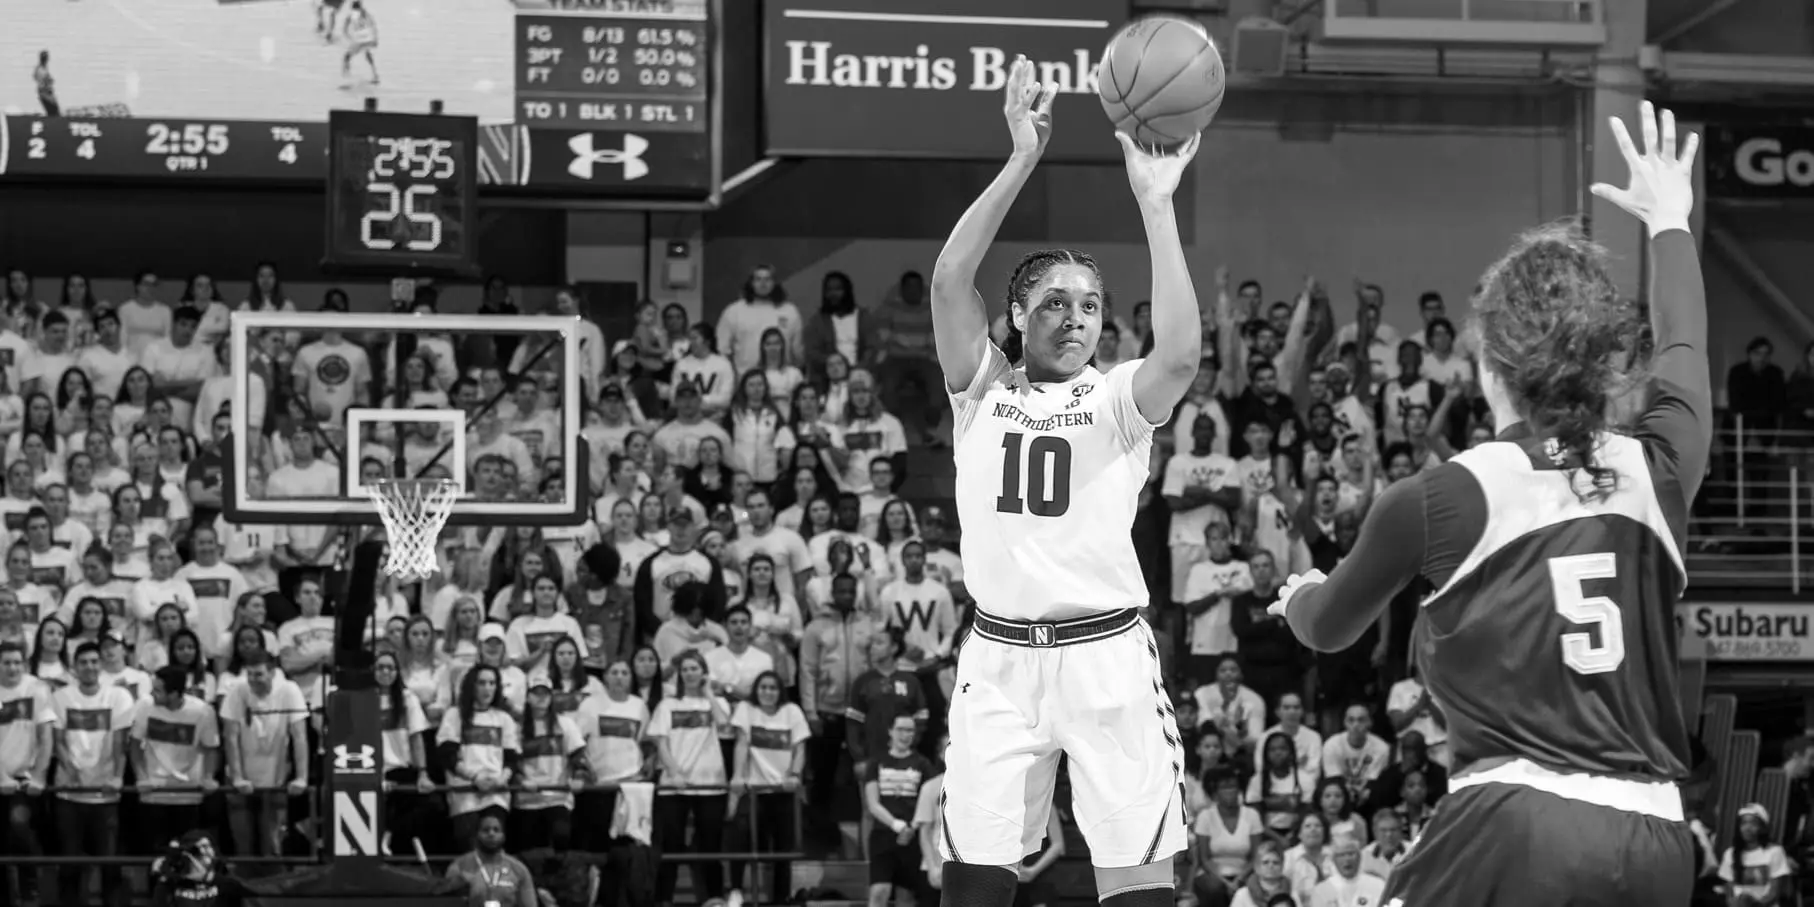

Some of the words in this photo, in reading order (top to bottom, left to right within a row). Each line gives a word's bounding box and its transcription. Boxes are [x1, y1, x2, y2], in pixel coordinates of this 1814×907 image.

[527, 25, 552, 41] FG
[582, 27, 624, 43] 8/13
[527, 47, 563, 64] 3PT
[588, 47, 618, 64] 1/2
[785, 40, 957, 90] Harris
[969, 46, 1101, 94] Bnk
[527, 67, 552, 83] FT
[581, 67, 620, 84] 0/0
[639, 68, 671, 86] 0.0
[523, 102, 552, 118] TO
[559, 102, 566, 118] 1
[579, 103, 617, 120] BLK
[625, 104, 632, 120] 1
[641, 105, 678, 121] STL
[685, 105, 694, 121] 1
[68, 122, 103, 137] TOL
[146, 123, 229, 154] 2:55
[270, 126, 304, 142] TOL
[28, 137, 46, 158] 2
[76, 139, 96, 159] 4
[278, 143, 298, 164] 4
[1734, 137, 1814, 187] Go
[361, 182, 442, 250] 25
[992, 402, 1094, 431] NORTHWESTERN
[996, 431, 1072, 518] 10
[895, 600, 937, 631] W
[1547, 552, 1625, 675] 5
[1696, 607, 1808, 638] Subaru
[1035, 627, 1049, 645] N
[334, 790, 378, 856] N
